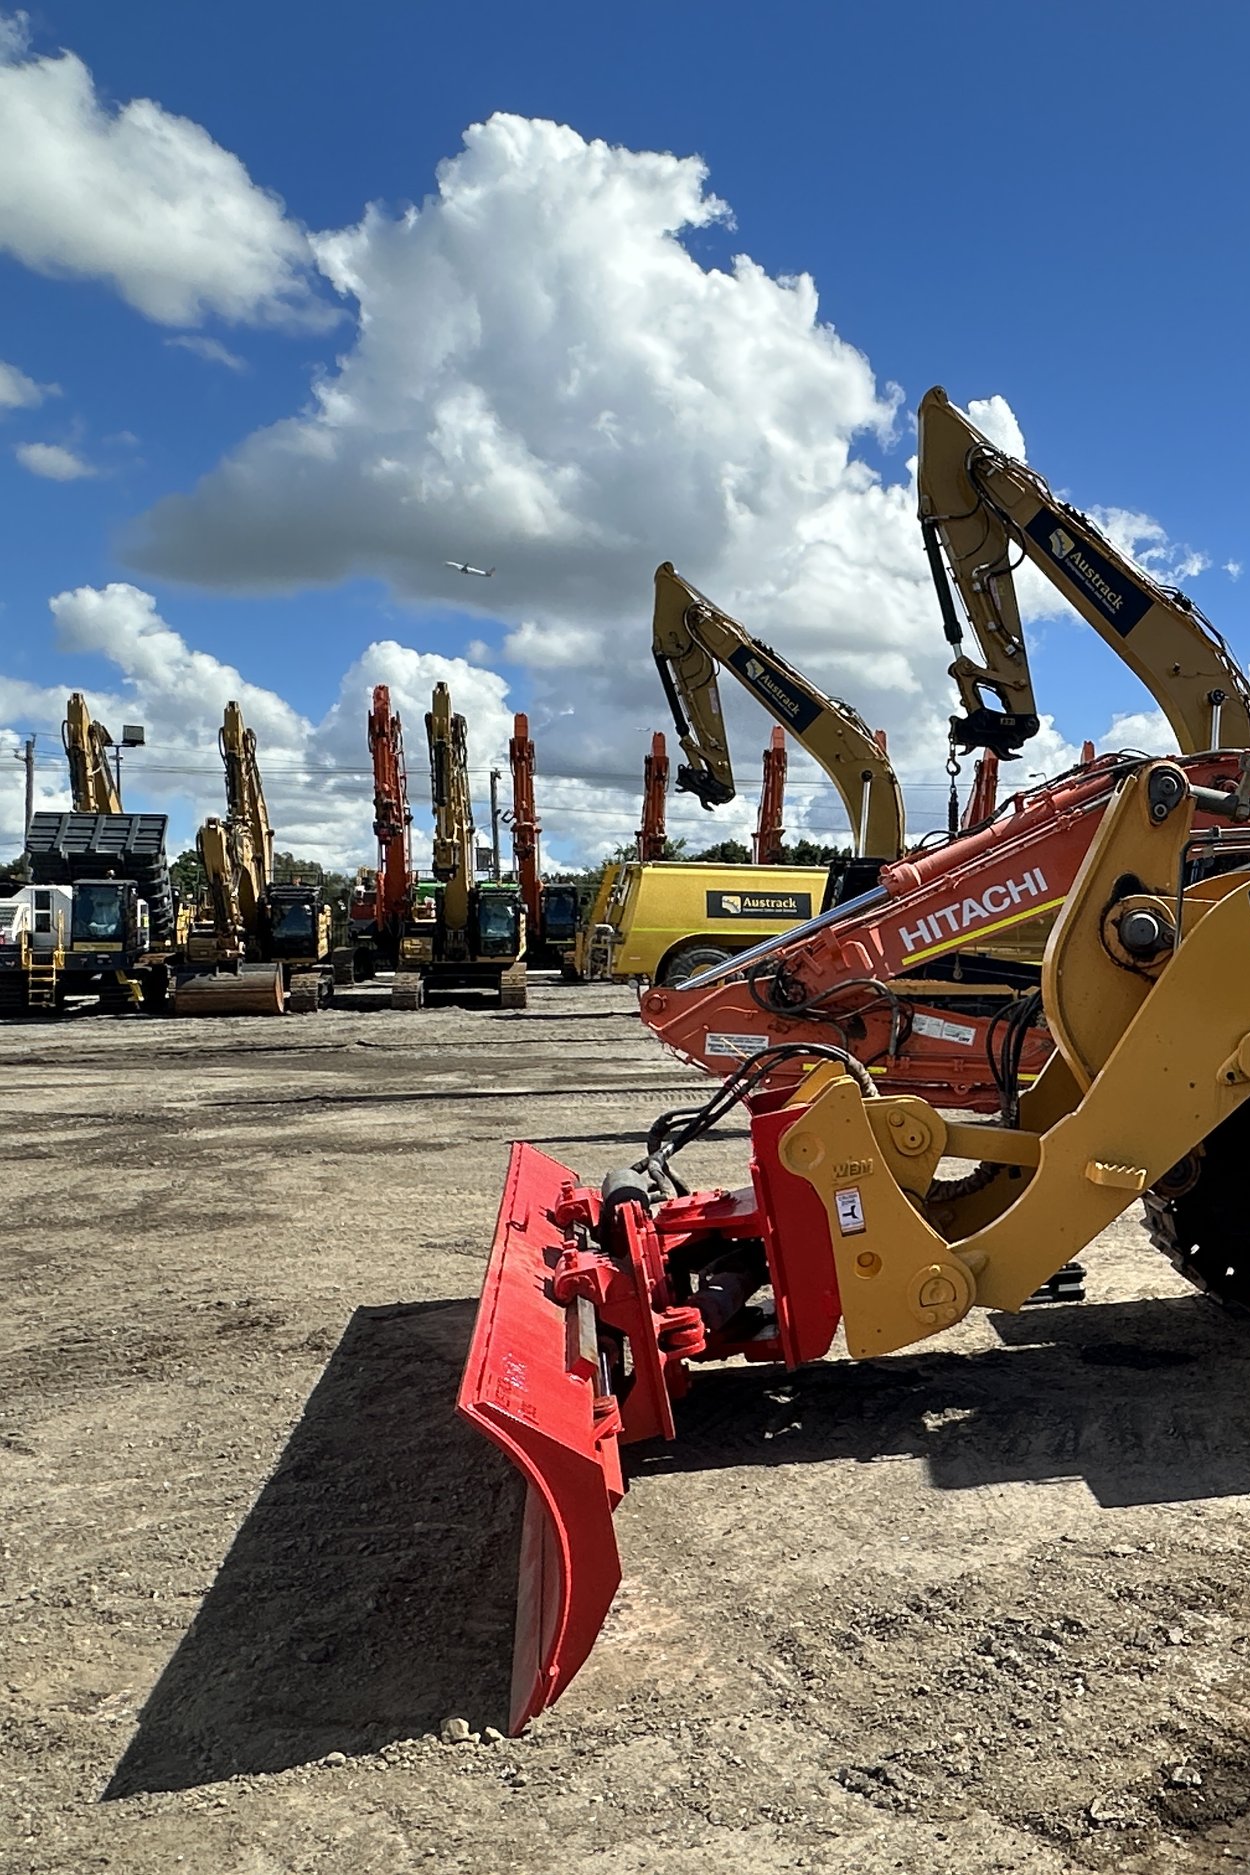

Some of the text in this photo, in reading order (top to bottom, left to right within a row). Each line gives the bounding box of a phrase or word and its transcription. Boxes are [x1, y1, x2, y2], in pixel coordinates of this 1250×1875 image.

[1070, 551, 1123, 610] Austrack
[760, 674, 801, 715] Austrack
[743, 897, 797, 908] Austrack
[898, 867, 1049, 952] HITACHI
